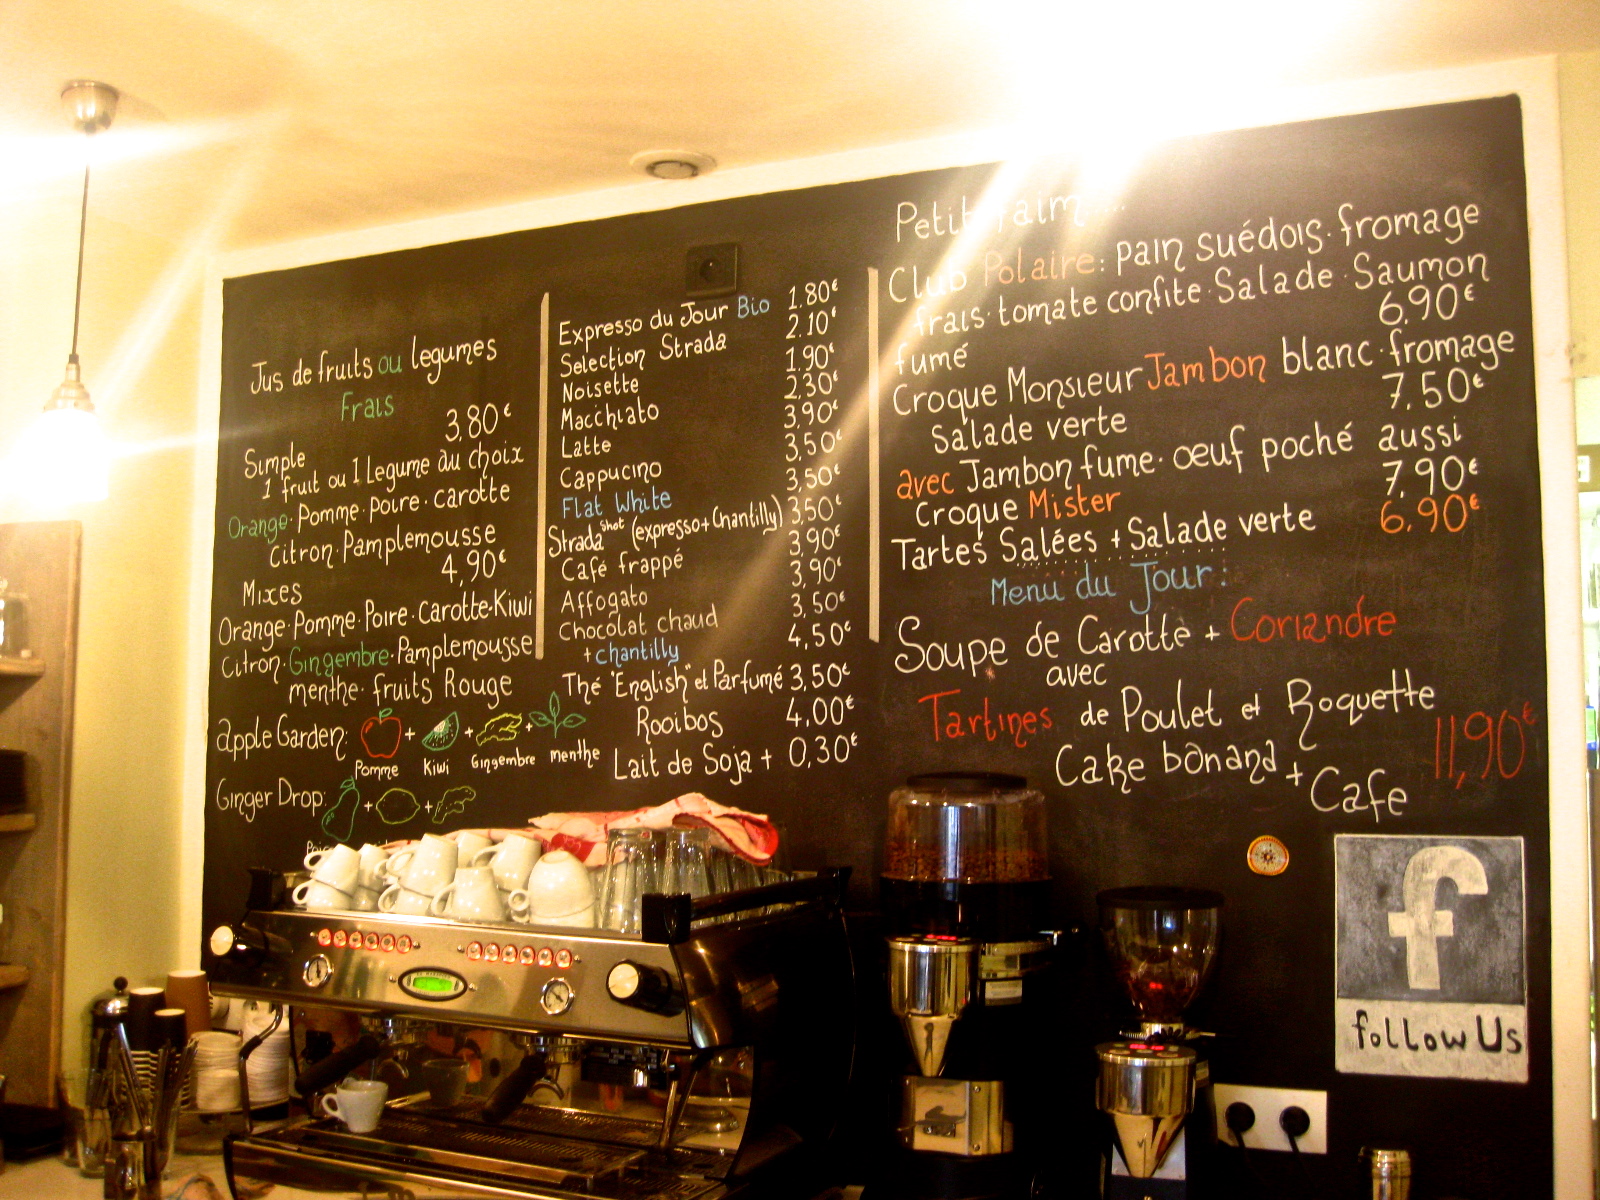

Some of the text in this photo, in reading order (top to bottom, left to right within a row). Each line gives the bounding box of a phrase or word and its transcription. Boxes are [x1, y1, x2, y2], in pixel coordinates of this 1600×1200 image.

[896, 195, 978, 242] Petit
[889, 254, 968, 303] Club
[1117, 238, 1186, 276] pain
[1338, 203, 1479, 246] fromage
[915, 251, 1490, 336] frais tomate confite Salade Saumon
[559, 295, 770, 353] Expresso du Jour Bio
[250, 335, 498, 395] Jus de fruits ou legumes
[560, 330, 727, 378] Selection Strada
[893, 328, 1516, 424] Croque Monsieur Jambon blanc fromage
[895, 342, 969, 375] fumé
[340, 390, 395, 422] Frais
[562, 372, 639, 404] Noisette
[561, 395, 660, 431] Macchiato
[931, 406, 1128, 454] Salade verte
[243, 440, 307, 481] Simple
[561, 435, 612, 459] Latte
[896, 468, 955, 500] avec
[959, 455, 1073, 493] Jambon
[1081, 444, 1156, 480] fume
[1261, 420, 1354, 473] poché
[1378, 415, 1462, 452] aussi
[262, 477, 272, 500] 1
[282, 470, 320, 504] fruit
[328, 472, 347, 488] ou
[438, 447, 461, 474] au
[468, 440, 525, 482] choix
[560, 461, 662, 492] Cappucino
[562, 485, 673, 520] Flat White
[915, 484, 1121, 541] Croque Mister
[228, 513, 289, 545] Orange
[343, 523, 497, 566] Pamplemousse
[548, 524, 605, 558] Strada
[600, 519, 625, 533] shot
[891, 534, 988, 571] Tartes
[1000, 526, 1098, 563] Salées
[1128, 510, 1228, 551] Salade
[1238, 502, 1316, 537] verte
[561, 547, 684, 582] Café frappé
[991, 577, 1065, 607] Menu
[1076, 562, 1117, 600] du
[242, 578, 303, 607] Mixes
[560, 583, 649, 620] Affogato
[219, 615, 286, 653] Orange
[292, 609, 356, 639] Pomme
[364, 598, 408, 632] Poire
[494, 587, 534, 618] Kiwi
[559, 606, 719, 642] Chocolat chaud
[895, 615, 1009, 677] Soupe
[1026, 620, 1061, 659] de
[1077, 612, 1191, 655] Carotte
[1231, 594, 1398, 643] Coriandre
[288, 640, 389, 678] Gingembre
[397, 634, 533, 673] Pamplemousse
[595, 636, 680, 668] chantilly
[289, 667, 513, 711] menthe fruits Rouge
[561, 671, 602, 706] Thé
[694, 676, 709, 691] et
[713, 658, 784, 695] Parfumé
[1046, 662, 1108, 688] avec
[636, 704, 724, 745] Rooibos
[918, 689, 1054, 749] Tartines
[1080, 667, 1435, 751] de Poulet et Roquette
[354, 738, 601, 780] Pomme Kiwi Gingembre menthe
[614, 747, 660, 781] Lait
[667, 749, 694, 776] de
[702, 740, 753, 787] Soja
[1055, 736, 1146, 795] Cake
[1310, 765, 1408, 823] Cafe
[215, 776, 273, 823] Ginger
[1476, 1014, 1522, 1055] Us
